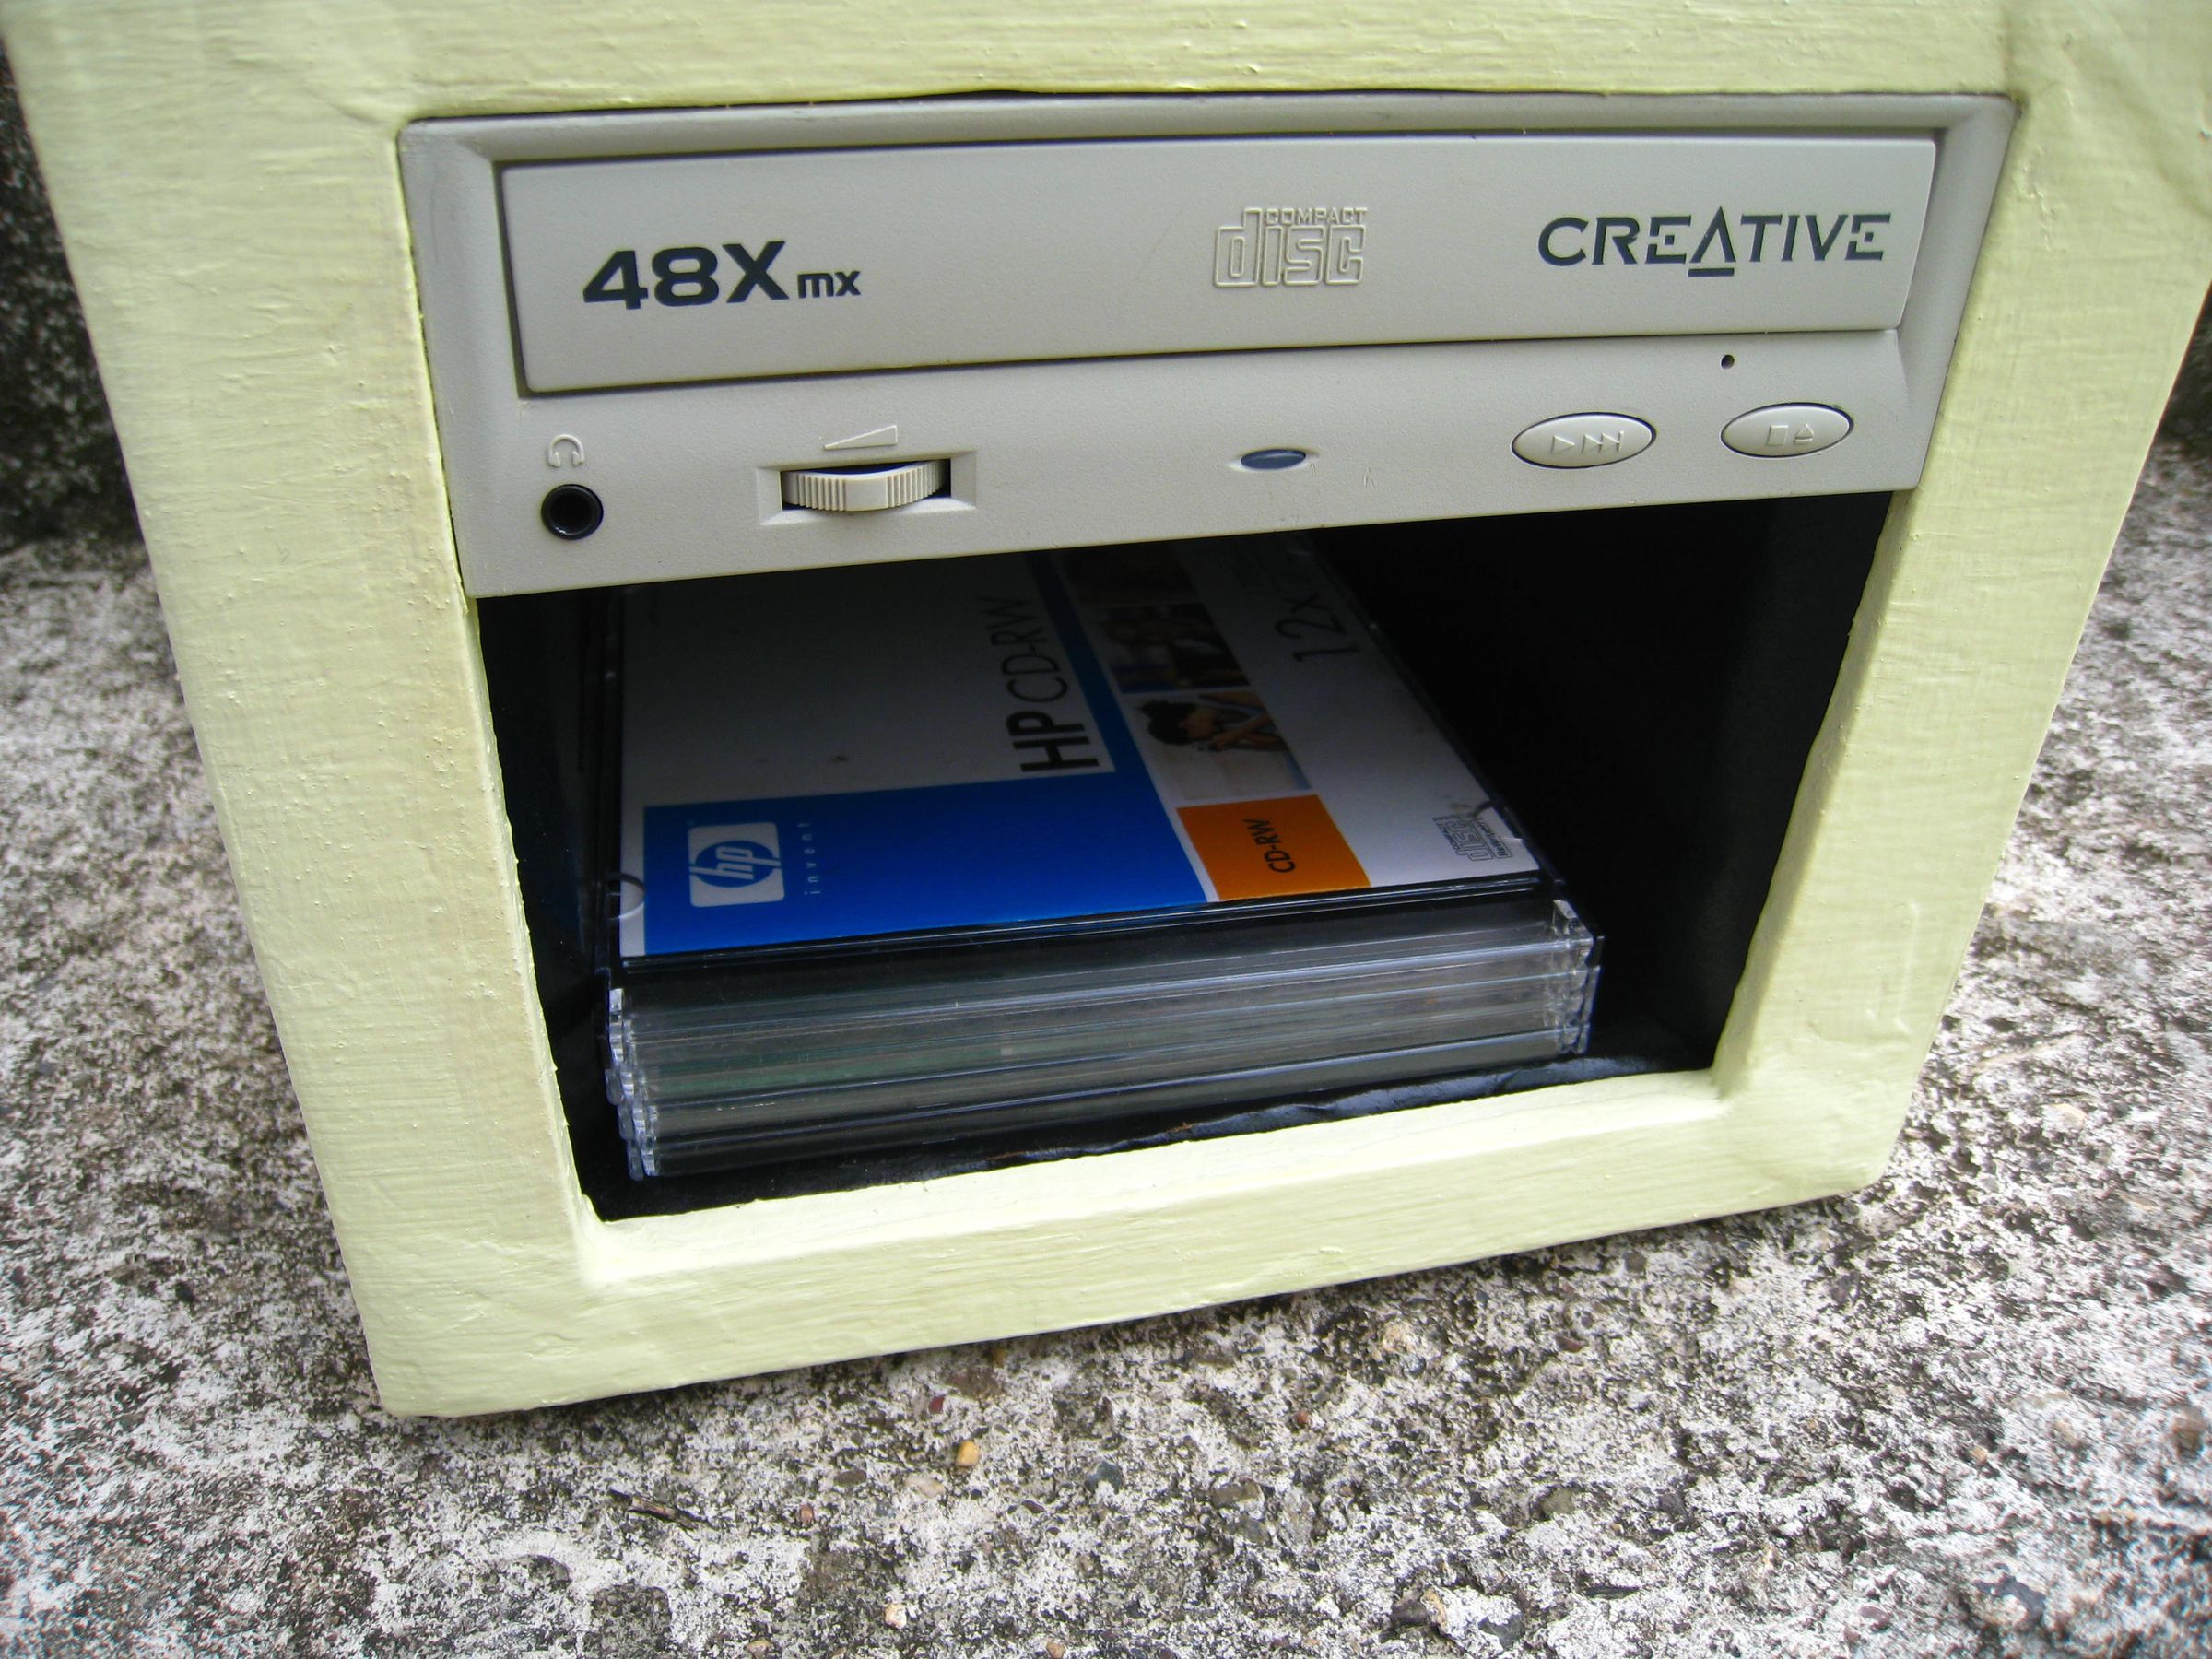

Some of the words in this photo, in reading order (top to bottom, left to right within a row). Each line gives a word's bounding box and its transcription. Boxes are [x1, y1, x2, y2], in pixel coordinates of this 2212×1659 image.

[1214, 208, 1366, 288] disc
[1265, 207, 1368, 225] COMPACT
[1538, 206, 1891, 276] CREATIVE
[582, 241, 789, 310] 48X
[797, 271, 861, 298] mx
[978, 596, 1068, 702] CD-RW
[1006, 711, 1099, 772] HP
[796, 822, 821, 895] invent
[1242, 819, 1296, 873] CD-RW
